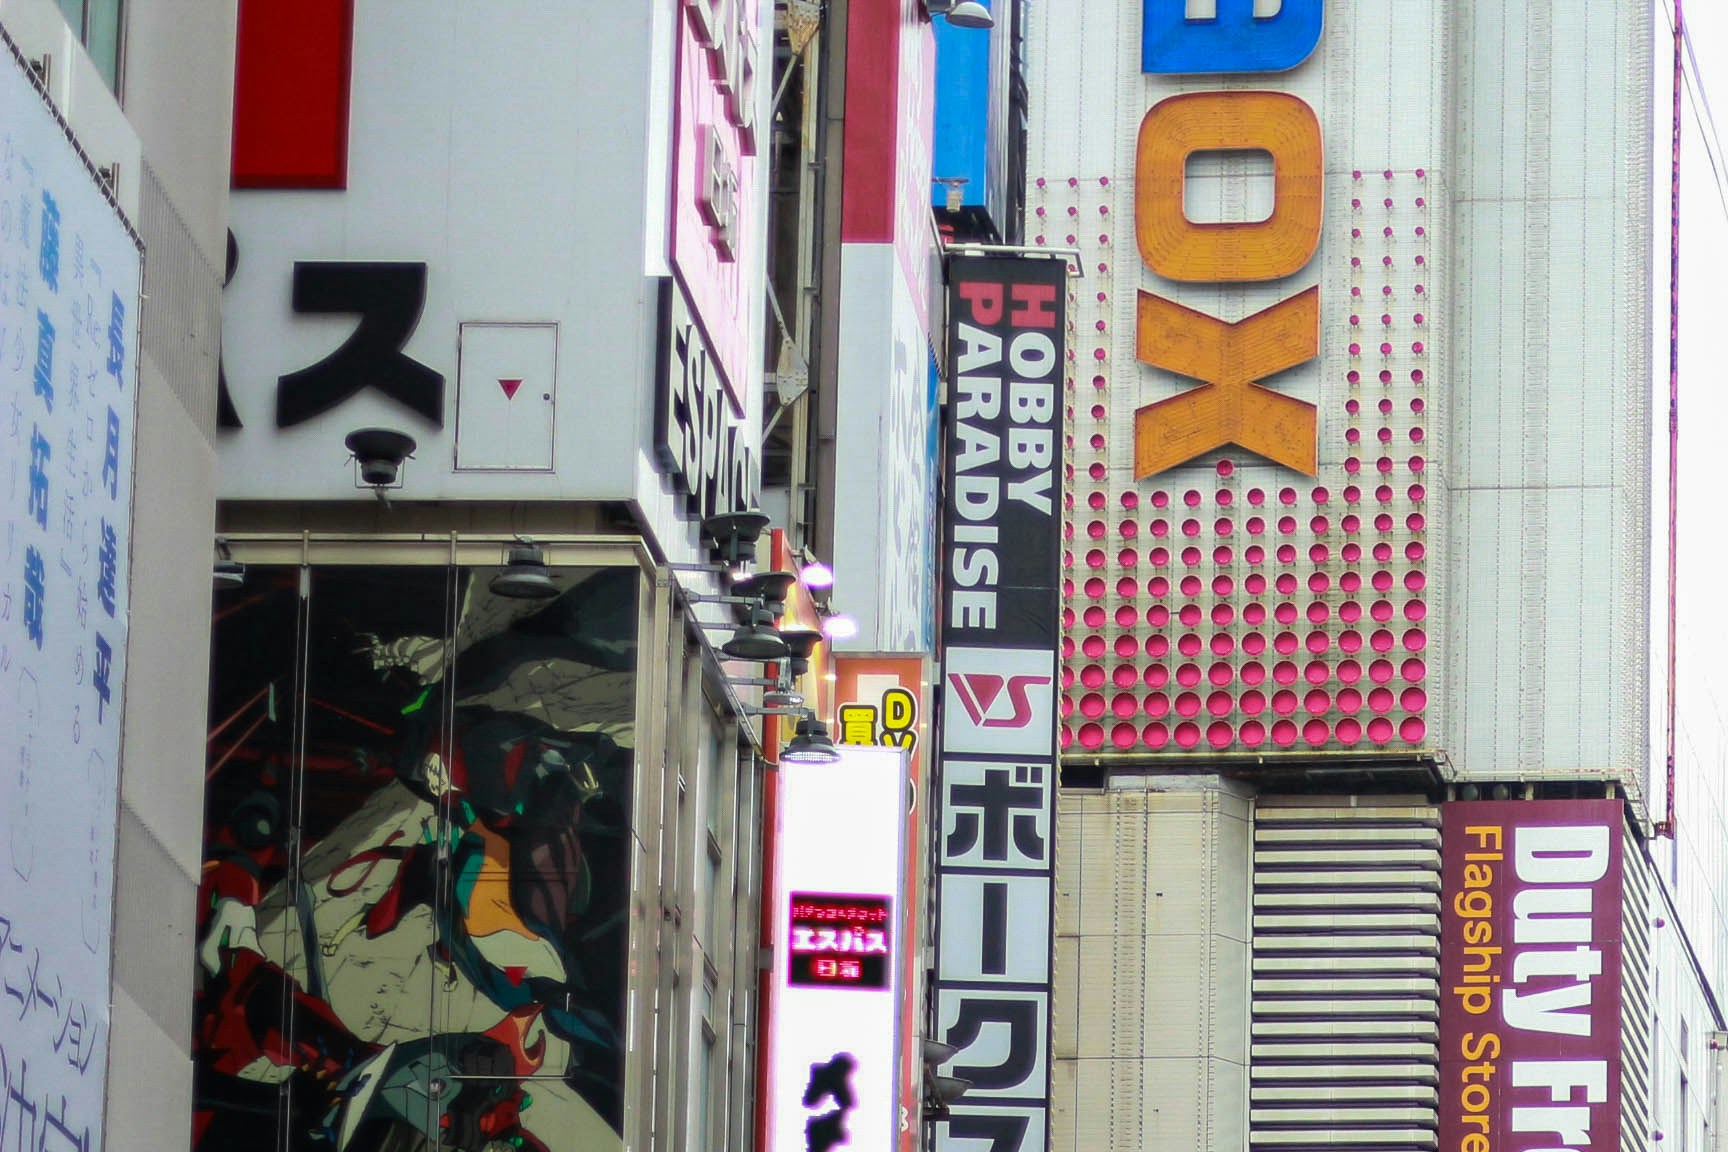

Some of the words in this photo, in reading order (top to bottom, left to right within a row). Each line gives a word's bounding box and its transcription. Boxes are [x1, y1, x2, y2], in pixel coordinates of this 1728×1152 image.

[950, 281, 1005, 632] PARADISE
[1008, 282, 1057, 517] HOBBY
[1453, 825, 1503, 1015] Flagship
[1502, 825, 1610, 1037] Duty
